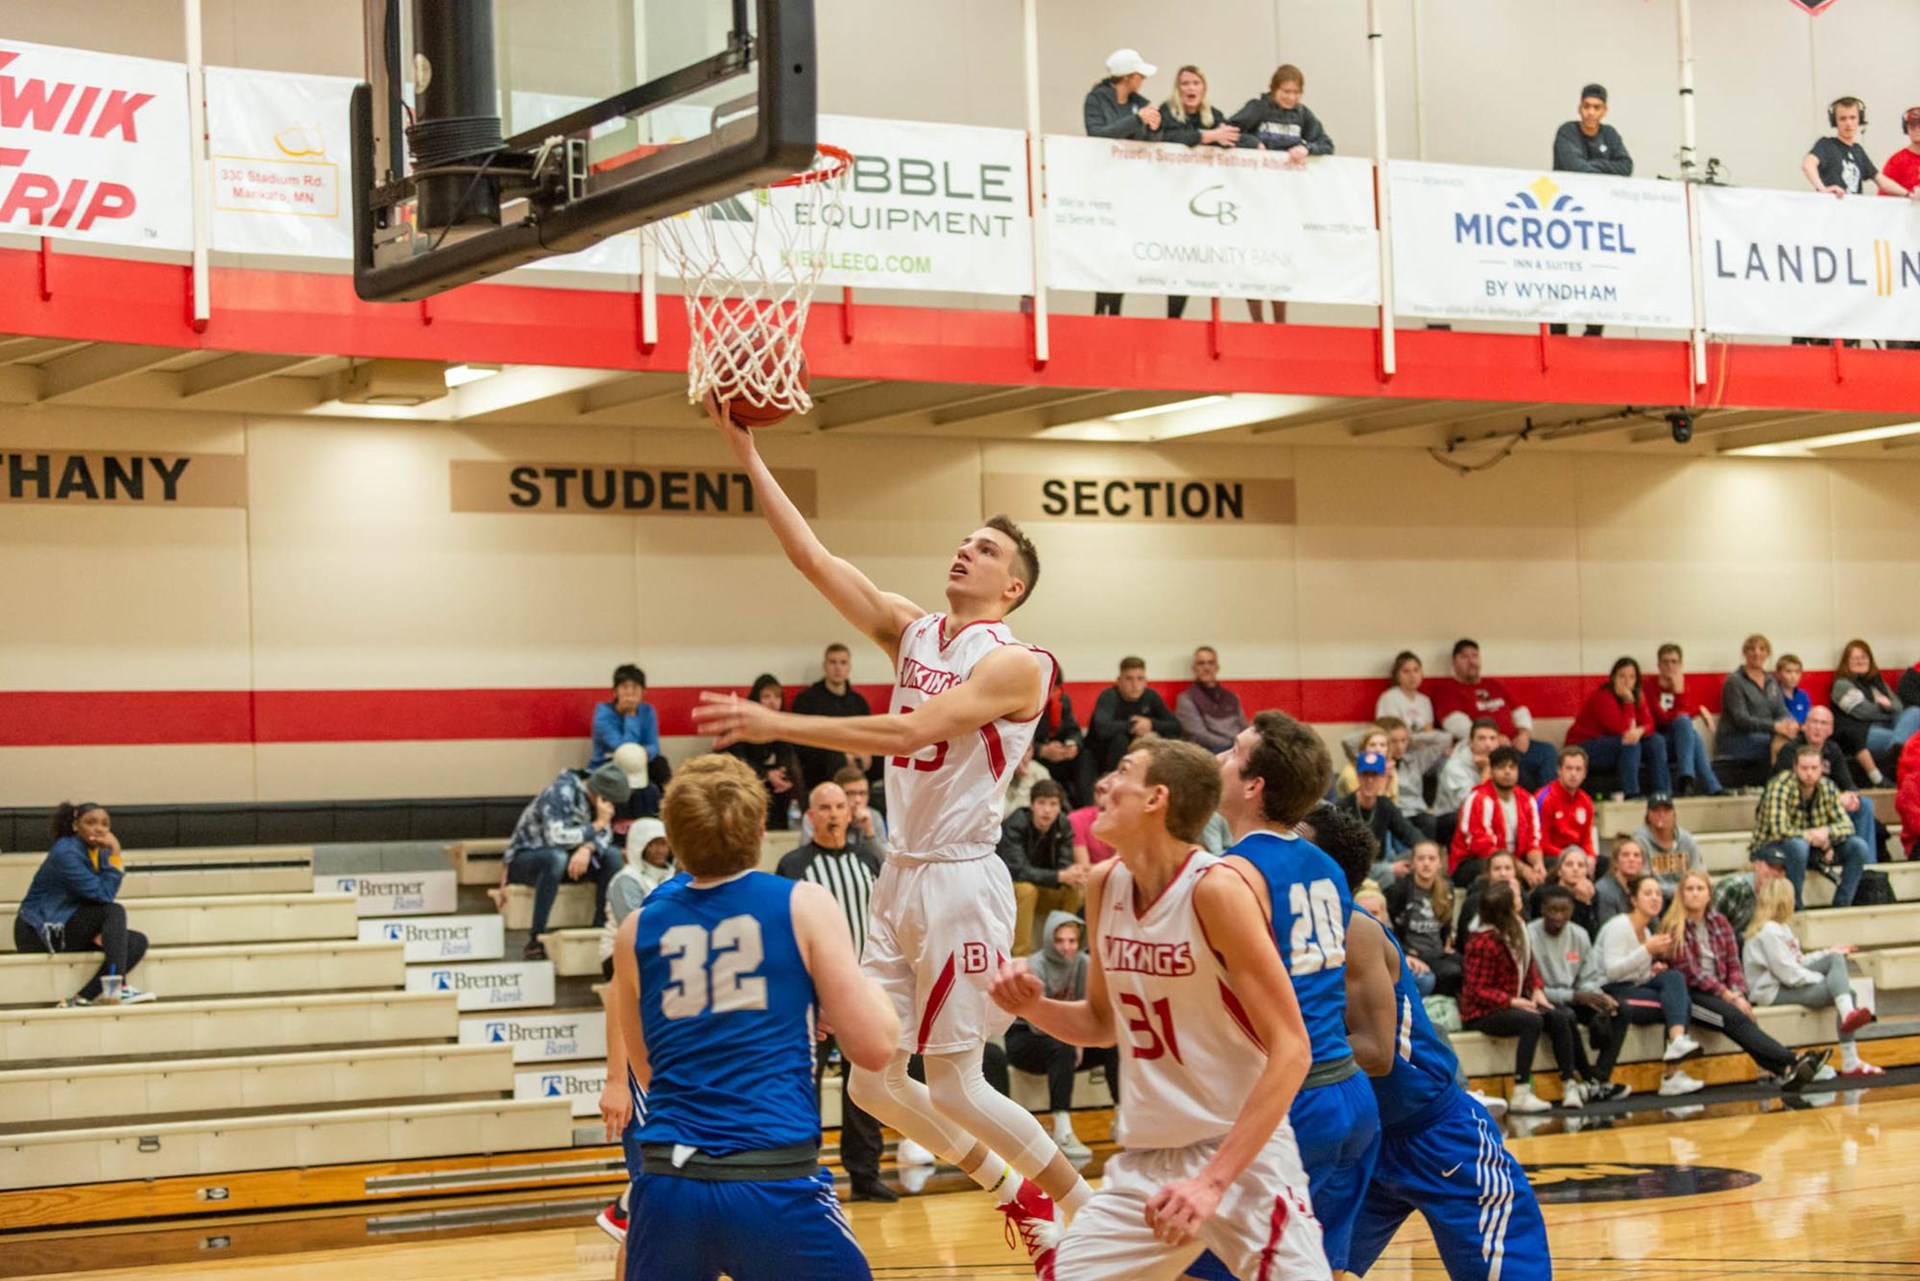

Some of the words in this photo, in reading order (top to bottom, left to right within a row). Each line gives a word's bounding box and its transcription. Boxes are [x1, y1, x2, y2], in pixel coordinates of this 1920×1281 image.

[248, 171, 299, 185] Stadium
[818, 155, 1013, 203] BBLE
[795, 202, 1013, 237] EQUIPMENT
[1455, 212, 1636, 254] MICROTEL
[1131, 241, 1246, 266] COMMUNITY
[1485, 280, 1507, 297] BY
[1516, 282, 1617, 301] WYNDHAM
[0, 454, 190, 501] HANY
[508, 466, 755, 513] STUDENT
[1041, 479, 1243, 519] SECTION
[358, 879, 425, 897] Bremer
[405, 924, 472, 941] Bremer
[1288, 878, 1346, 976] 20
[454, 971, 522, 990] Bremer
[660, 914, 768, 1020] 32
[508, 1022, 578, 1042] Bremer
[1119, 992, 1184, 1066] 31
[564, 1075, 607, 1095] Bre
